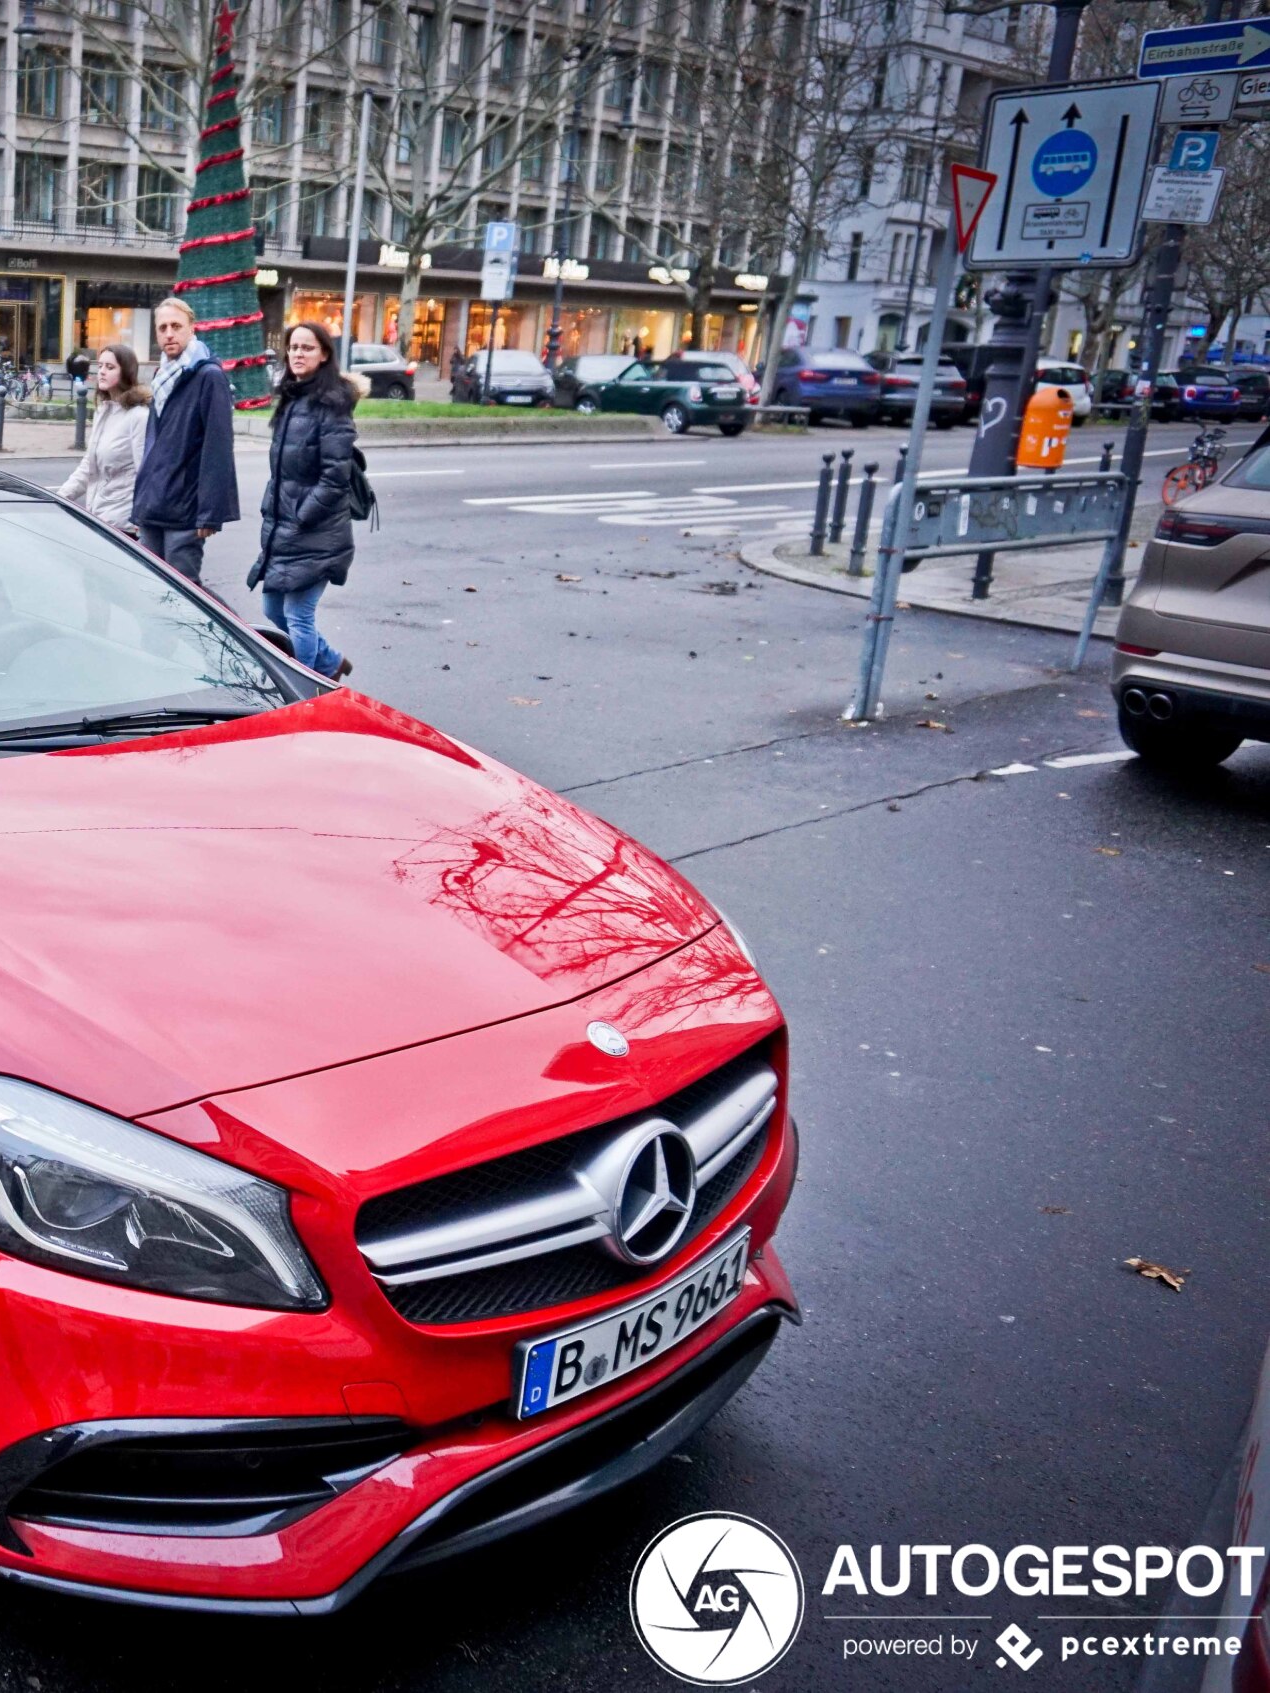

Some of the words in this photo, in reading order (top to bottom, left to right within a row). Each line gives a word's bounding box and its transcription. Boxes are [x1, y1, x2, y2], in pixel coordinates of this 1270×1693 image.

[1148, 40, 1244, 60] Einbahnstraße
[1240, 78, 1270, 95] Gie
[1179, 137, 1206, 166] P
[491, 226, 508, 248] P
[554, 1339, 586, 1398] B
[612, 1300, 667, 1372] MS
[674, 1243, 744, 1338] 9661
[531, 1386, 542, 1403] D
